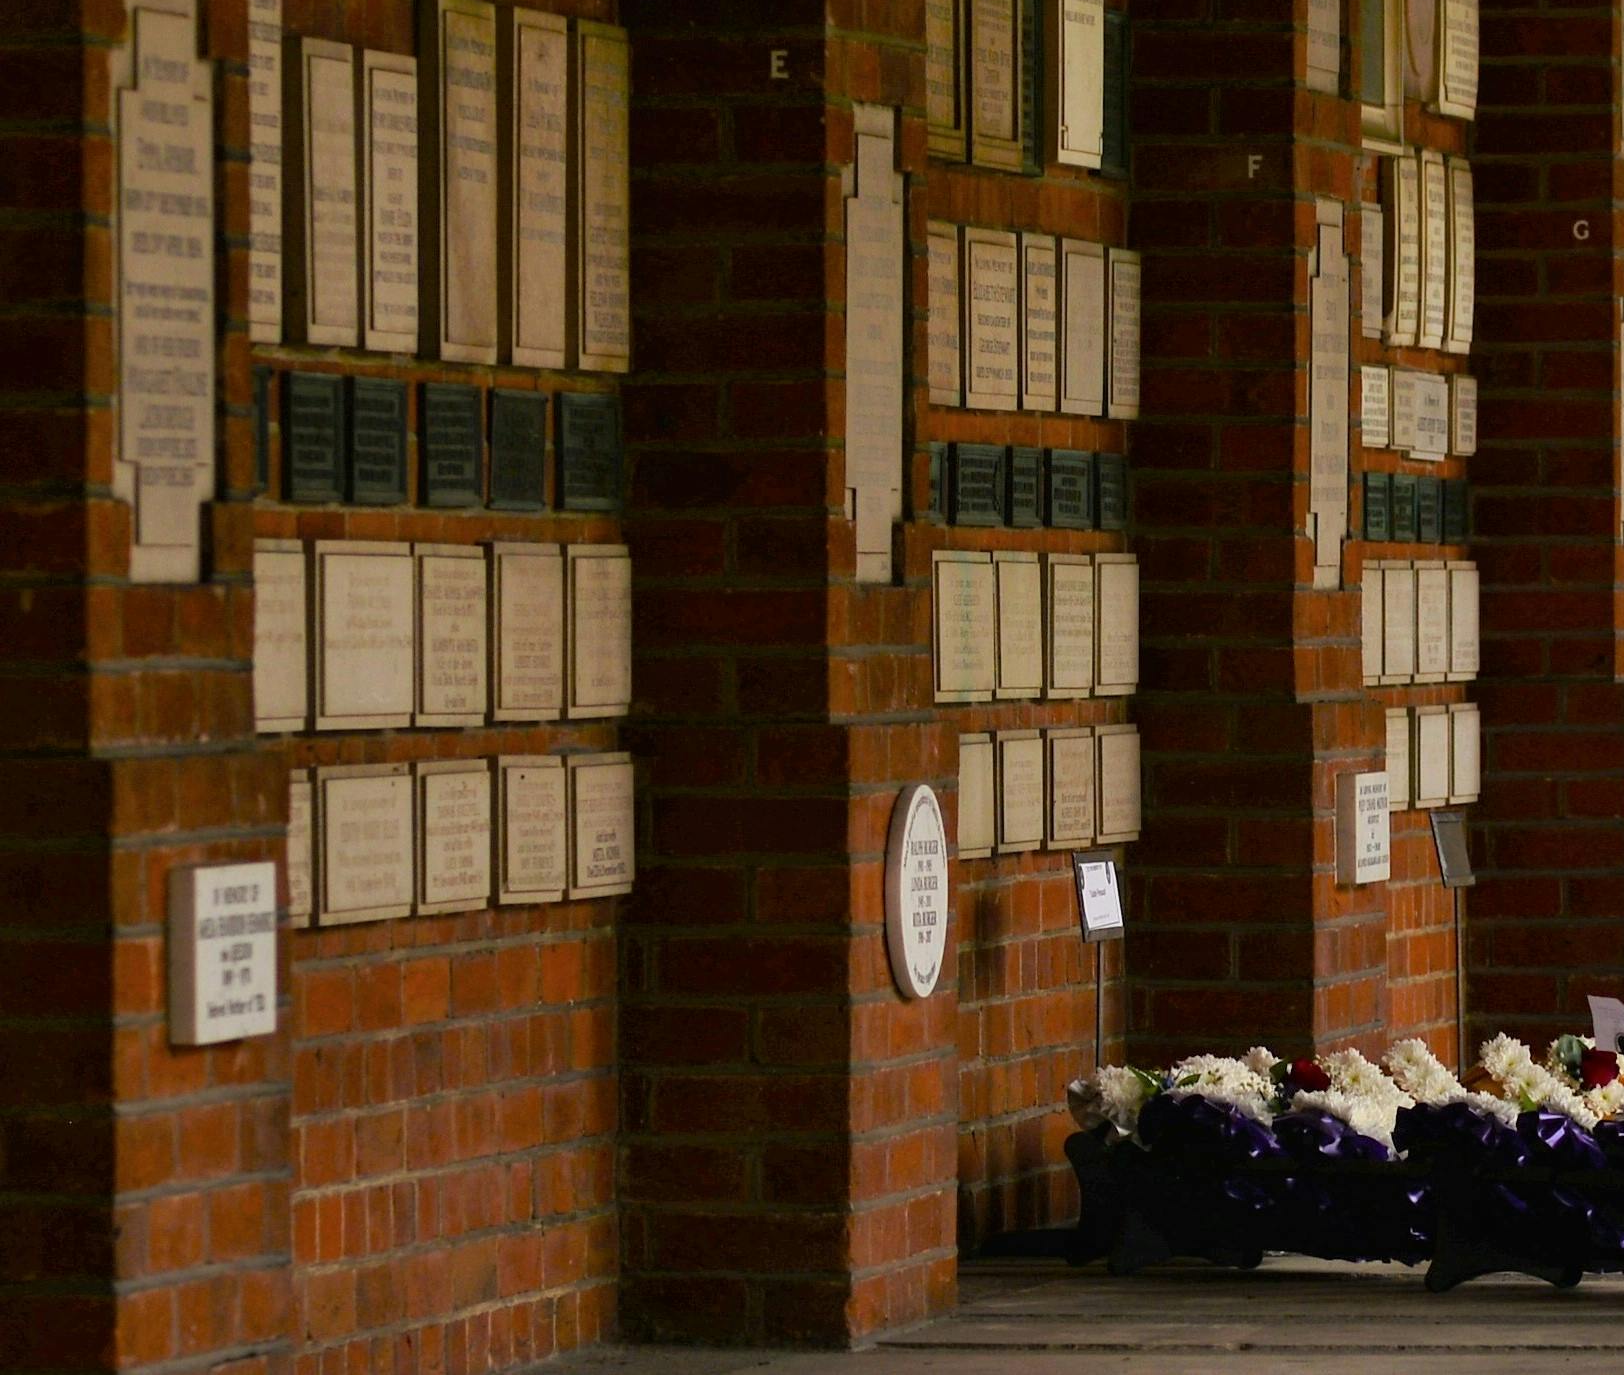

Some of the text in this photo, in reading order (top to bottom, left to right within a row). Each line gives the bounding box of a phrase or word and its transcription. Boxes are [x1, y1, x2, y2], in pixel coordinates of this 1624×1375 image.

[770, 50, 789, 79] E
[1248, 155, 1263, 179] F
[1573, 219, 1589, 240] G
